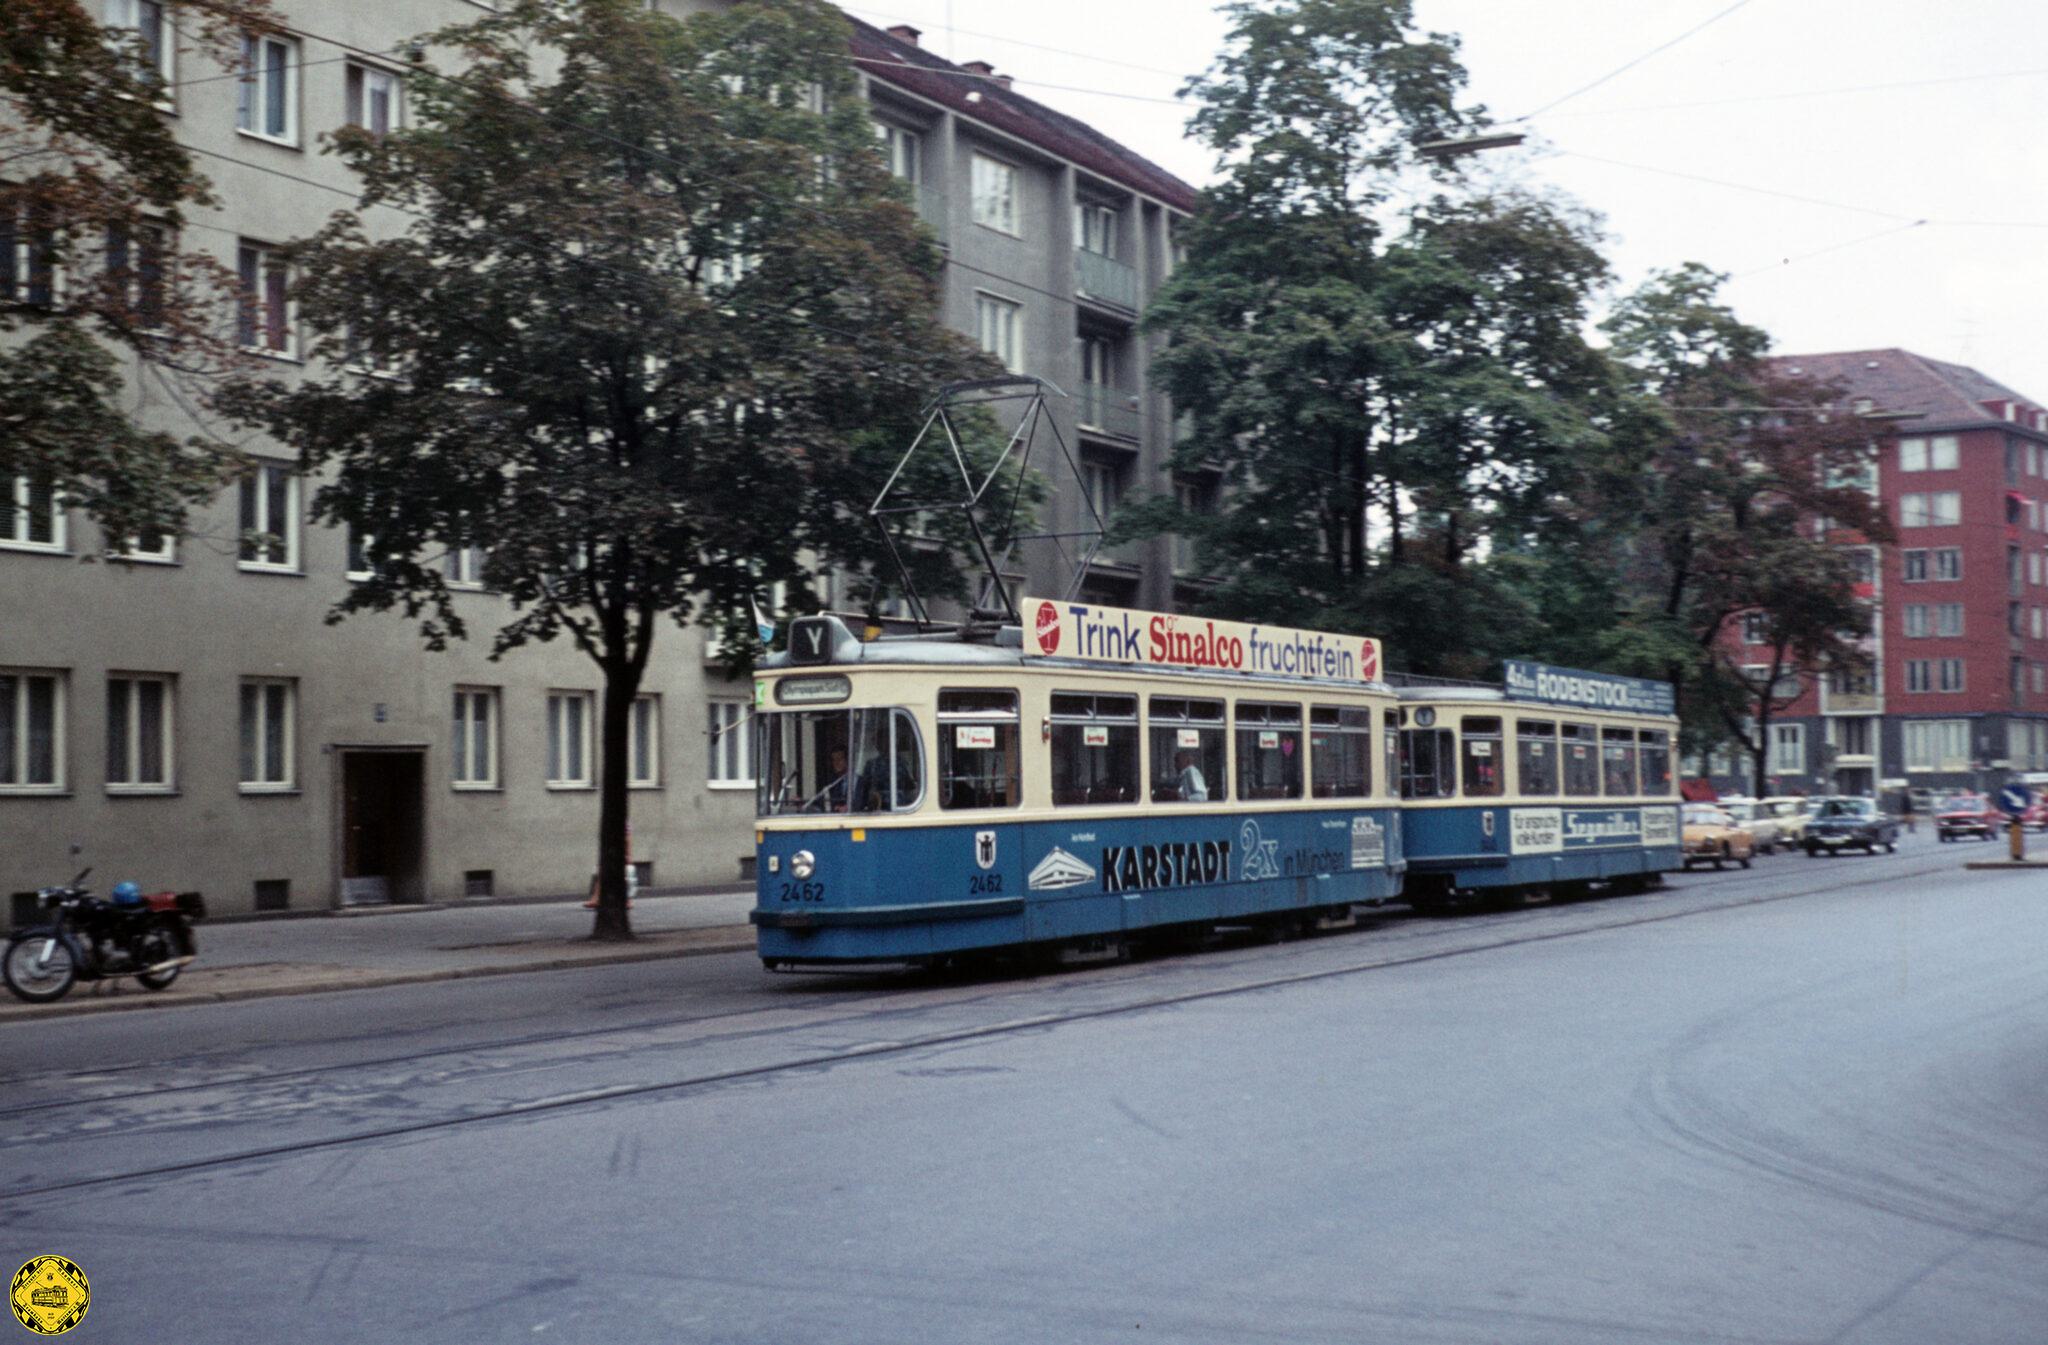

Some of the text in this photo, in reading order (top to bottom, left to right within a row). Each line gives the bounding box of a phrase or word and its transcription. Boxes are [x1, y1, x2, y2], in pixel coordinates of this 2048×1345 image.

[806, 627, 823, 655] Y
[1069, 606, 1353, 677] Trink Sinalco fruchtfein
[1102, 840, 1233, 894] KARSTADT
[780, 882, 825, 902] 2462
[969, 874, 1003, 895] 2462
